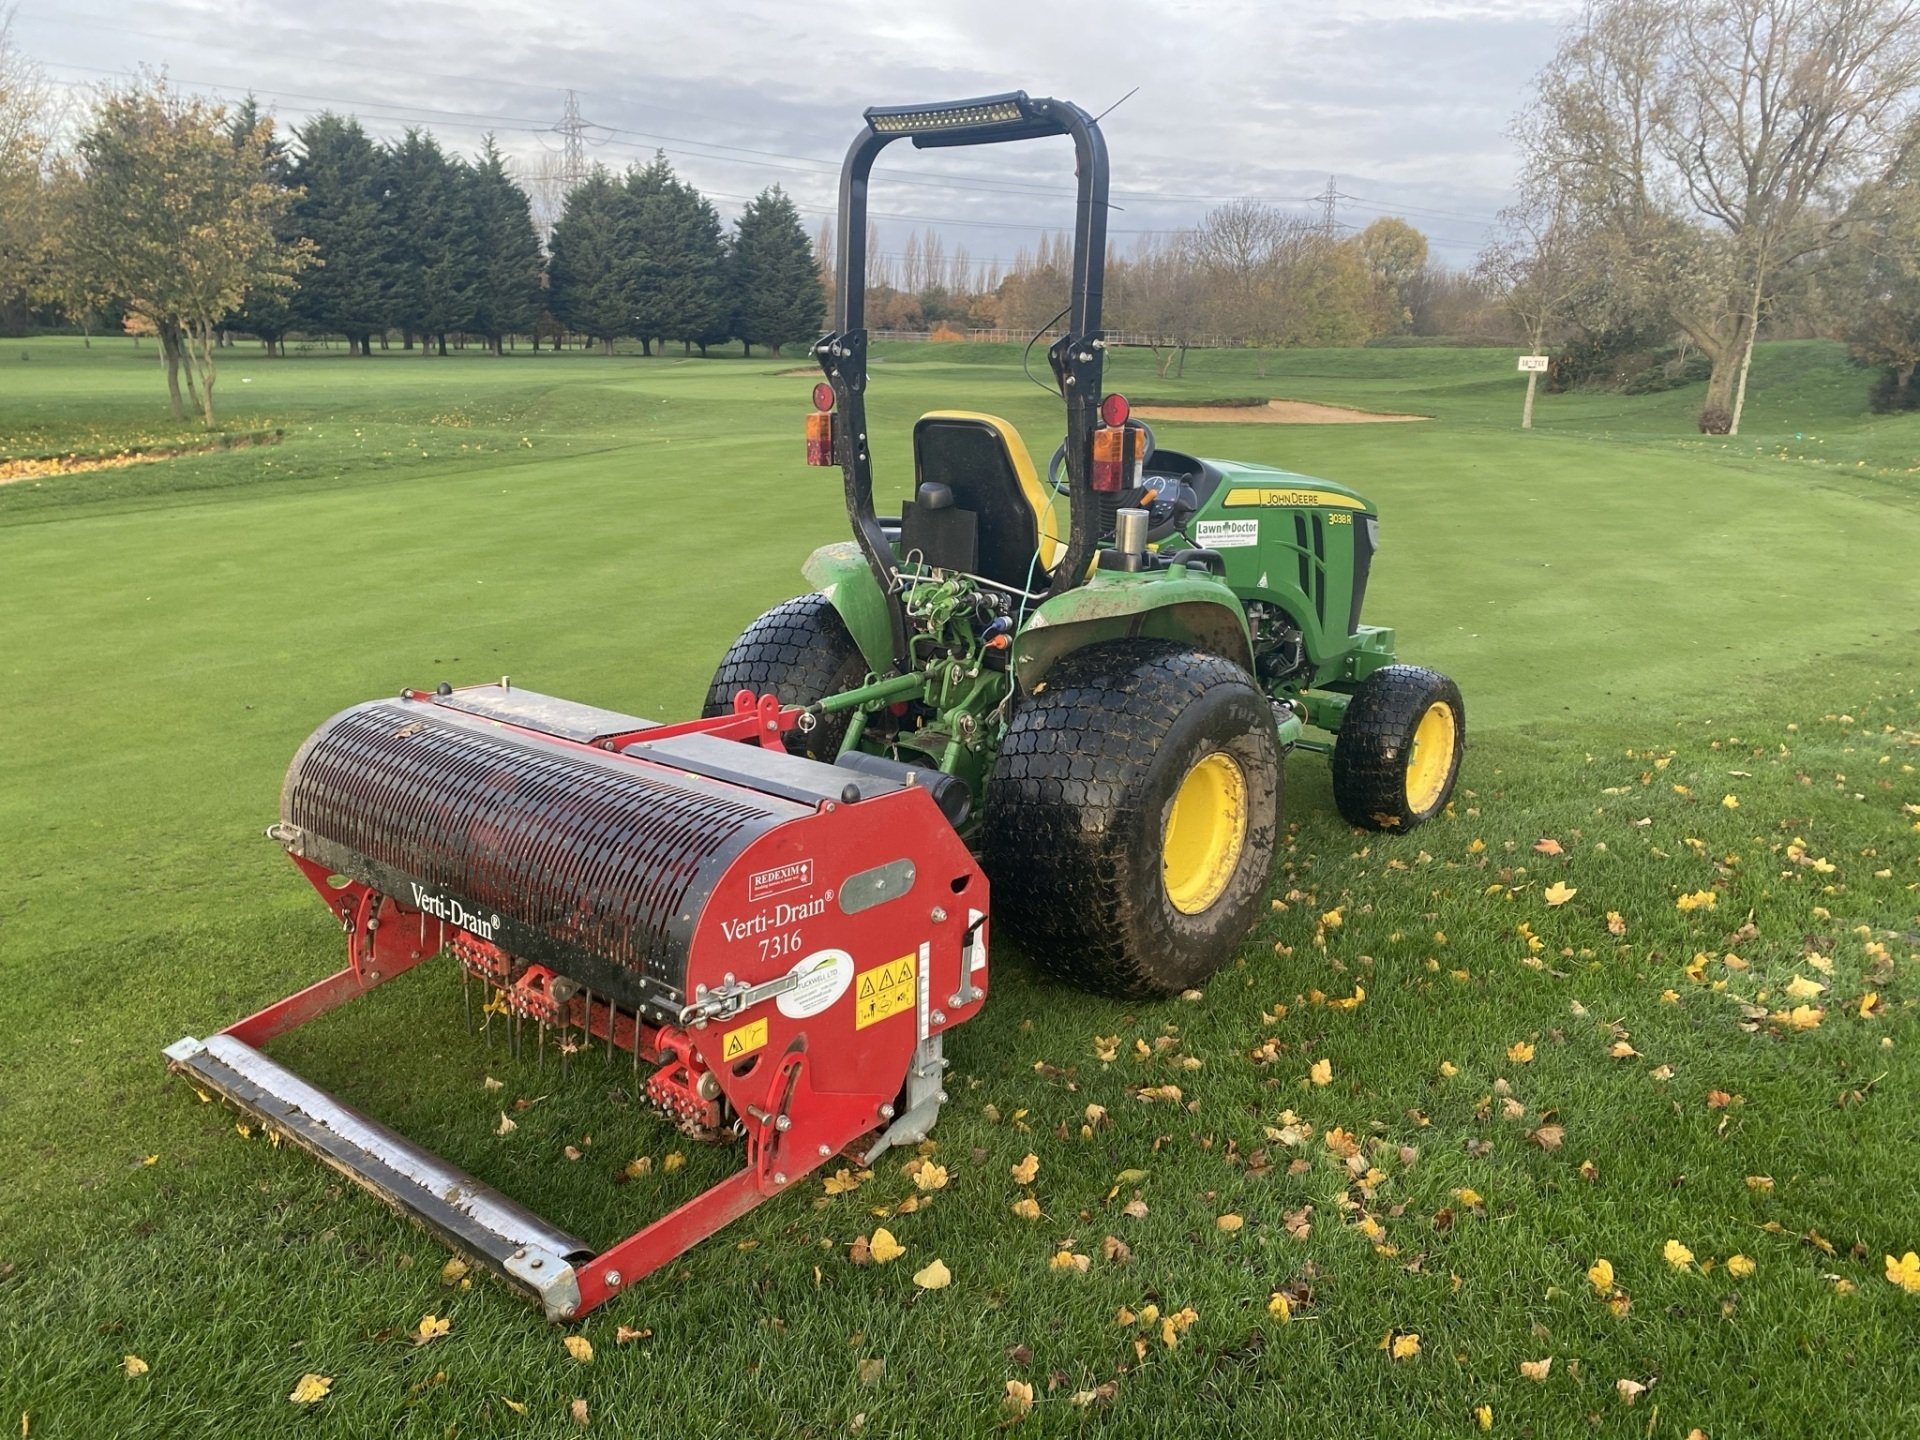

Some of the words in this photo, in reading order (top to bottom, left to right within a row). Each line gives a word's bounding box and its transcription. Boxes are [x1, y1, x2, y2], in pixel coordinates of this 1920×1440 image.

[1267, 493, 1291, 505] JOHN
[1291, 492, 1318, 505] DEERE
[1198, 524, 1222, 534] Lawn
[1231, 522, 1256, 533] Doctor
[754, 864, 800, 886] REDEXIM
[758, 929, 802, 962] 7316
